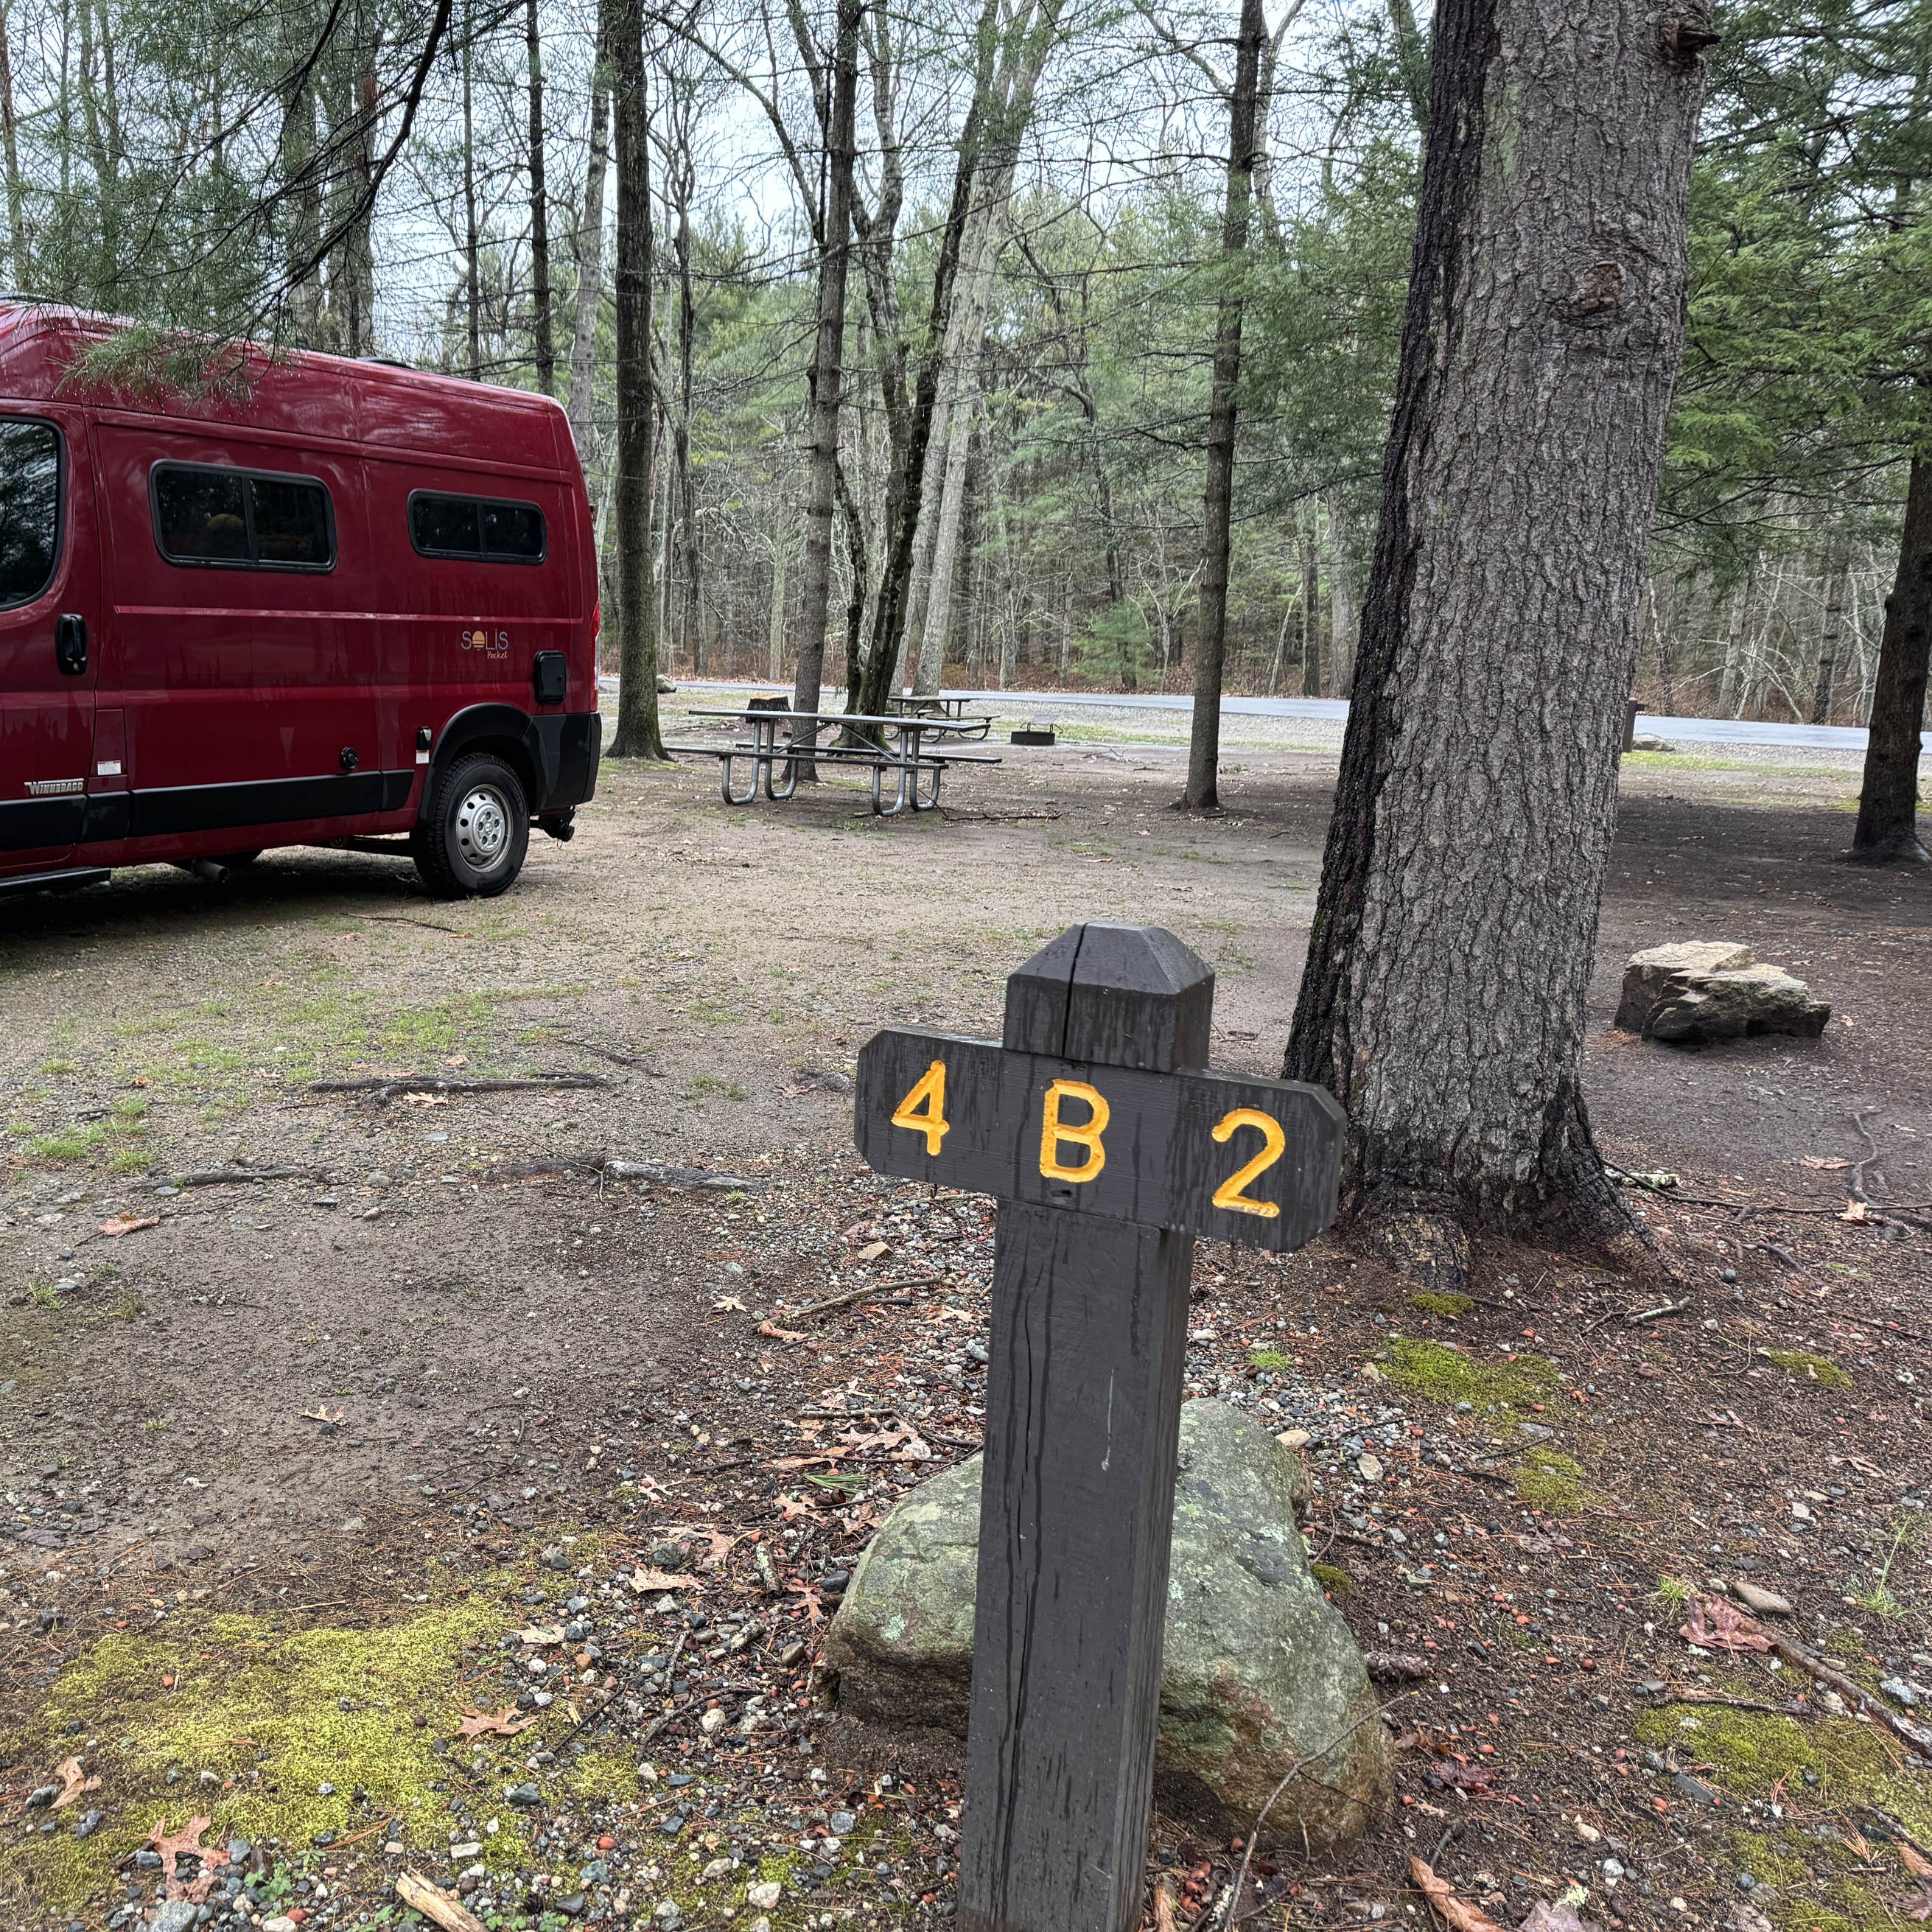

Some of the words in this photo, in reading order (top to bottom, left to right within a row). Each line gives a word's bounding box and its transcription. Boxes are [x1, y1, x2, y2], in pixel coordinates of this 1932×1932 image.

[891, 1060, 950, 1156] 4
[1040, 1079, 1110, 1183] B
[1211, 1108, 1286, 1218] 2
